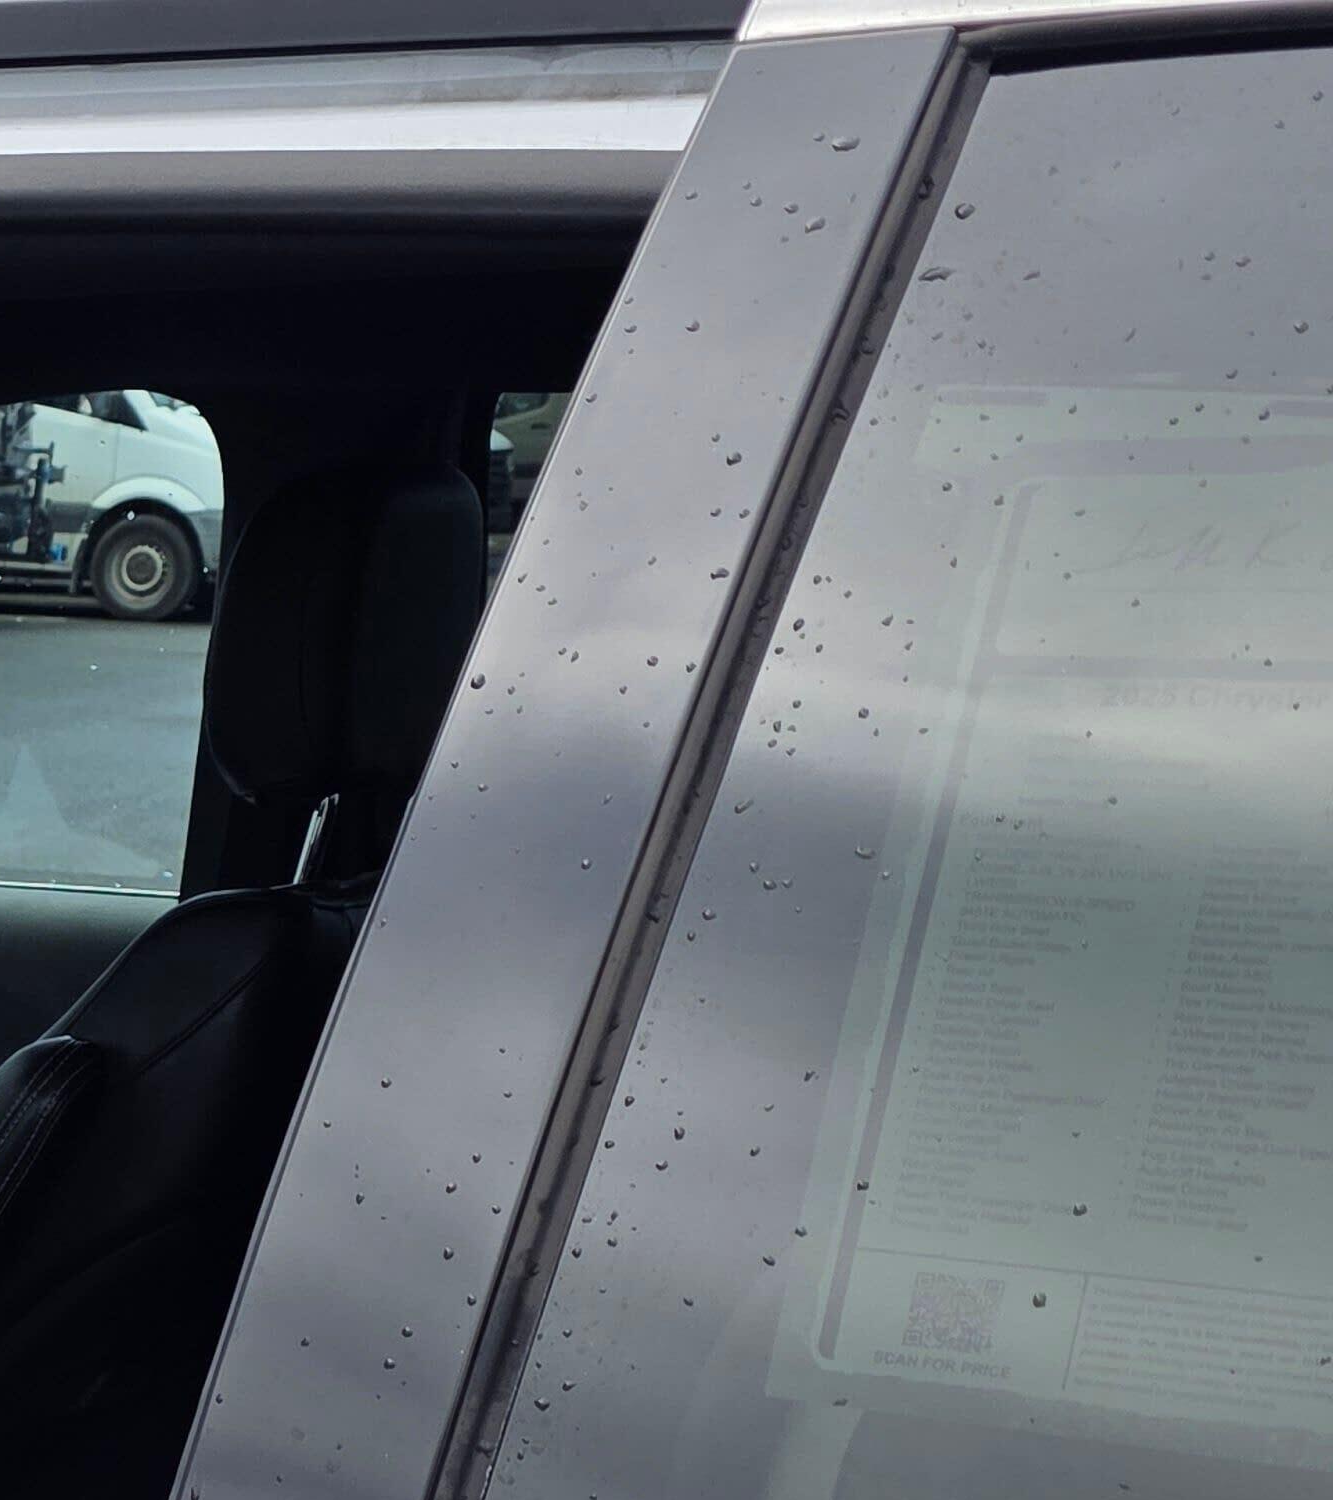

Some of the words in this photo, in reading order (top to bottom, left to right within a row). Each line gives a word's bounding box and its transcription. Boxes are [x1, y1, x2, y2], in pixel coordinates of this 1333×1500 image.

[873, 1350, 918, 1368] SCAN
[923, 1355, 957, 1373] FOR
[960, 1358, 1013, 1379] PRICE
